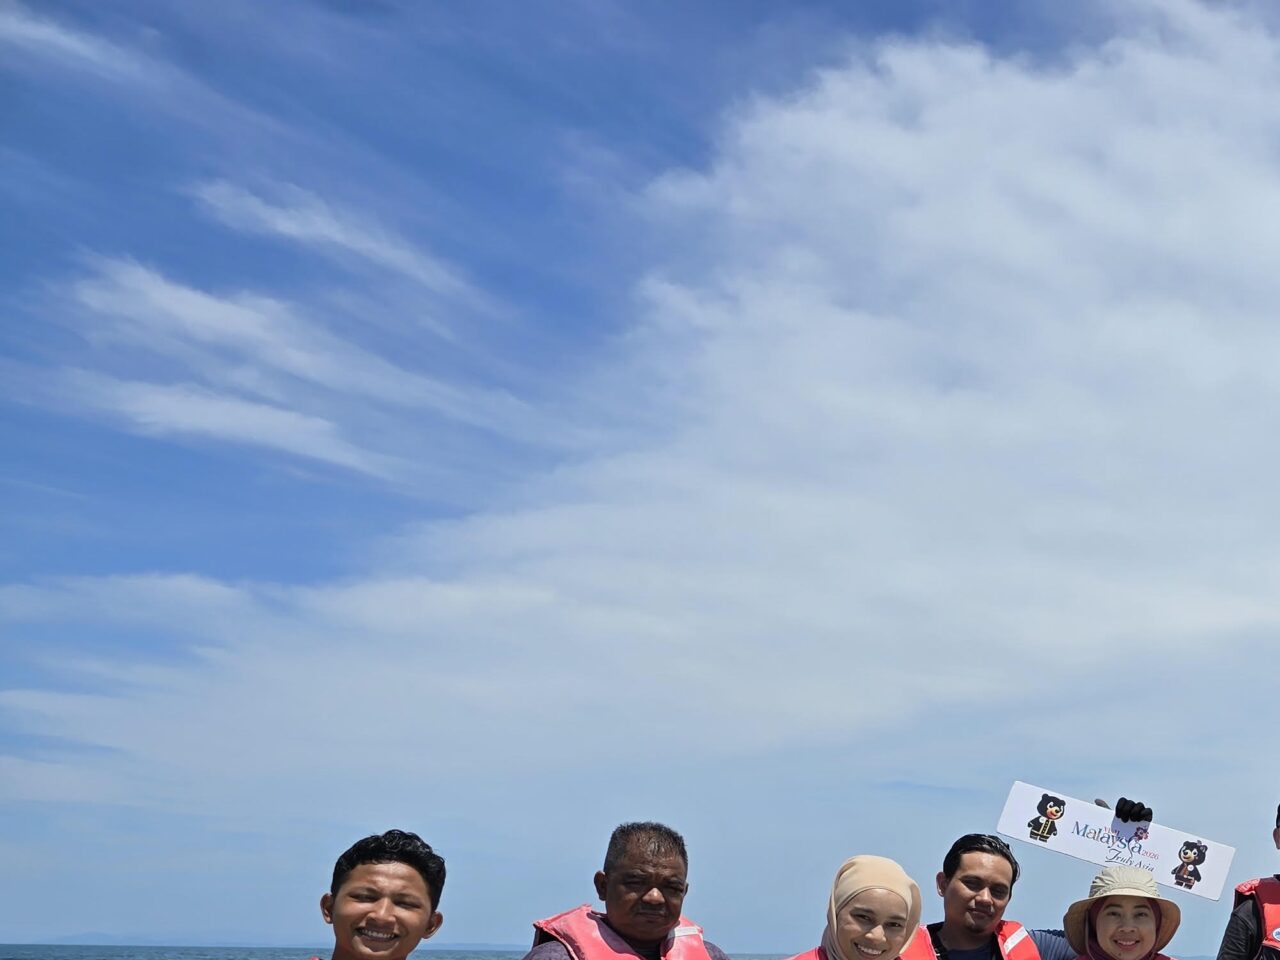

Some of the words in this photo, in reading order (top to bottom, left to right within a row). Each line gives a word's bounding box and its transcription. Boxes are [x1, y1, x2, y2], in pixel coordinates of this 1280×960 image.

[1071, 821, 1142, 856] Malaysia
[1141, 849, 1159, 860] 2026
[1105, 848, 1134, 866] Truly
[1134, 860, 1155, 872] Asia
